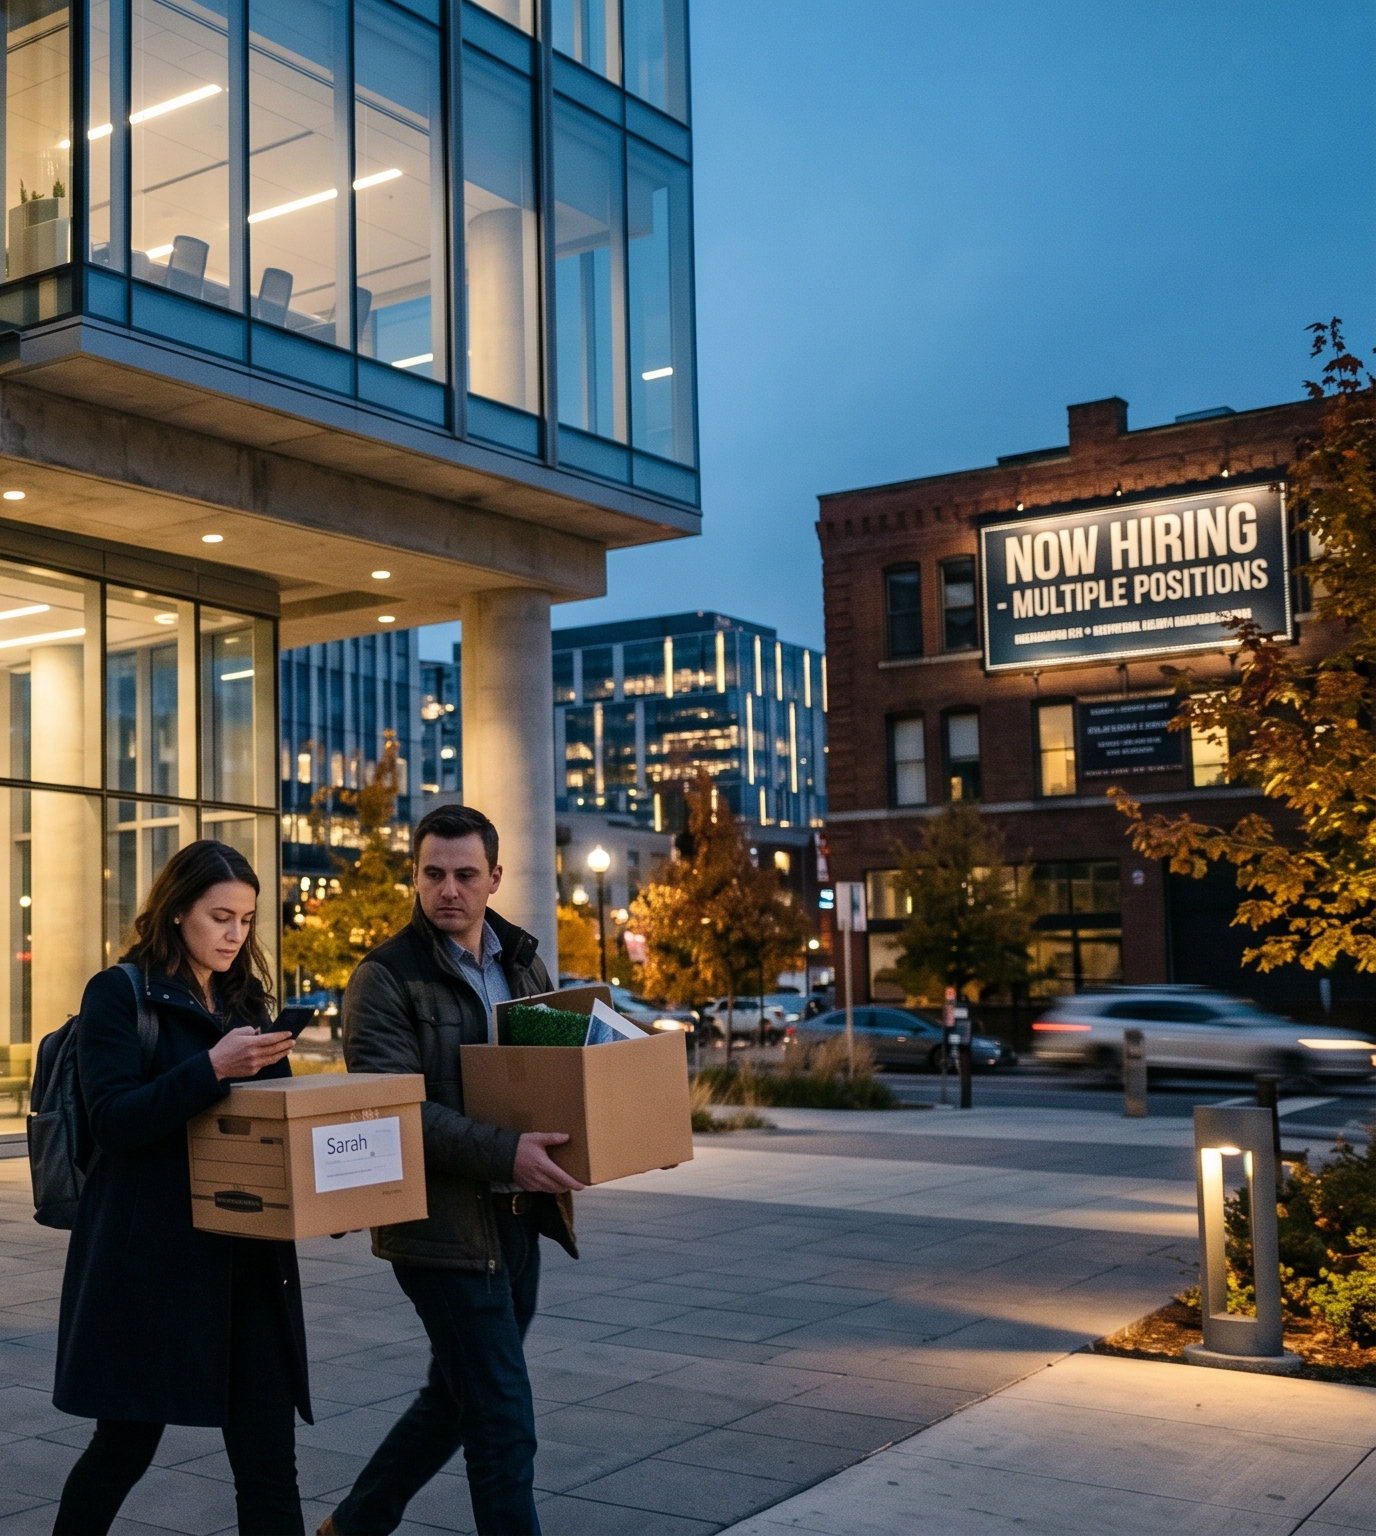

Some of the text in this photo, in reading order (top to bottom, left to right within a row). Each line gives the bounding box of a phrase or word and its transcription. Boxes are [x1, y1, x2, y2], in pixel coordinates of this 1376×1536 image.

[1005, 502, 1258, 585] NOW HIRING
[1012, 576, 1128, 619] MULTIPLE
[1134, 558, 1269, 604] POSITIONS
[327, 1134, 367, 1155] Sarah
